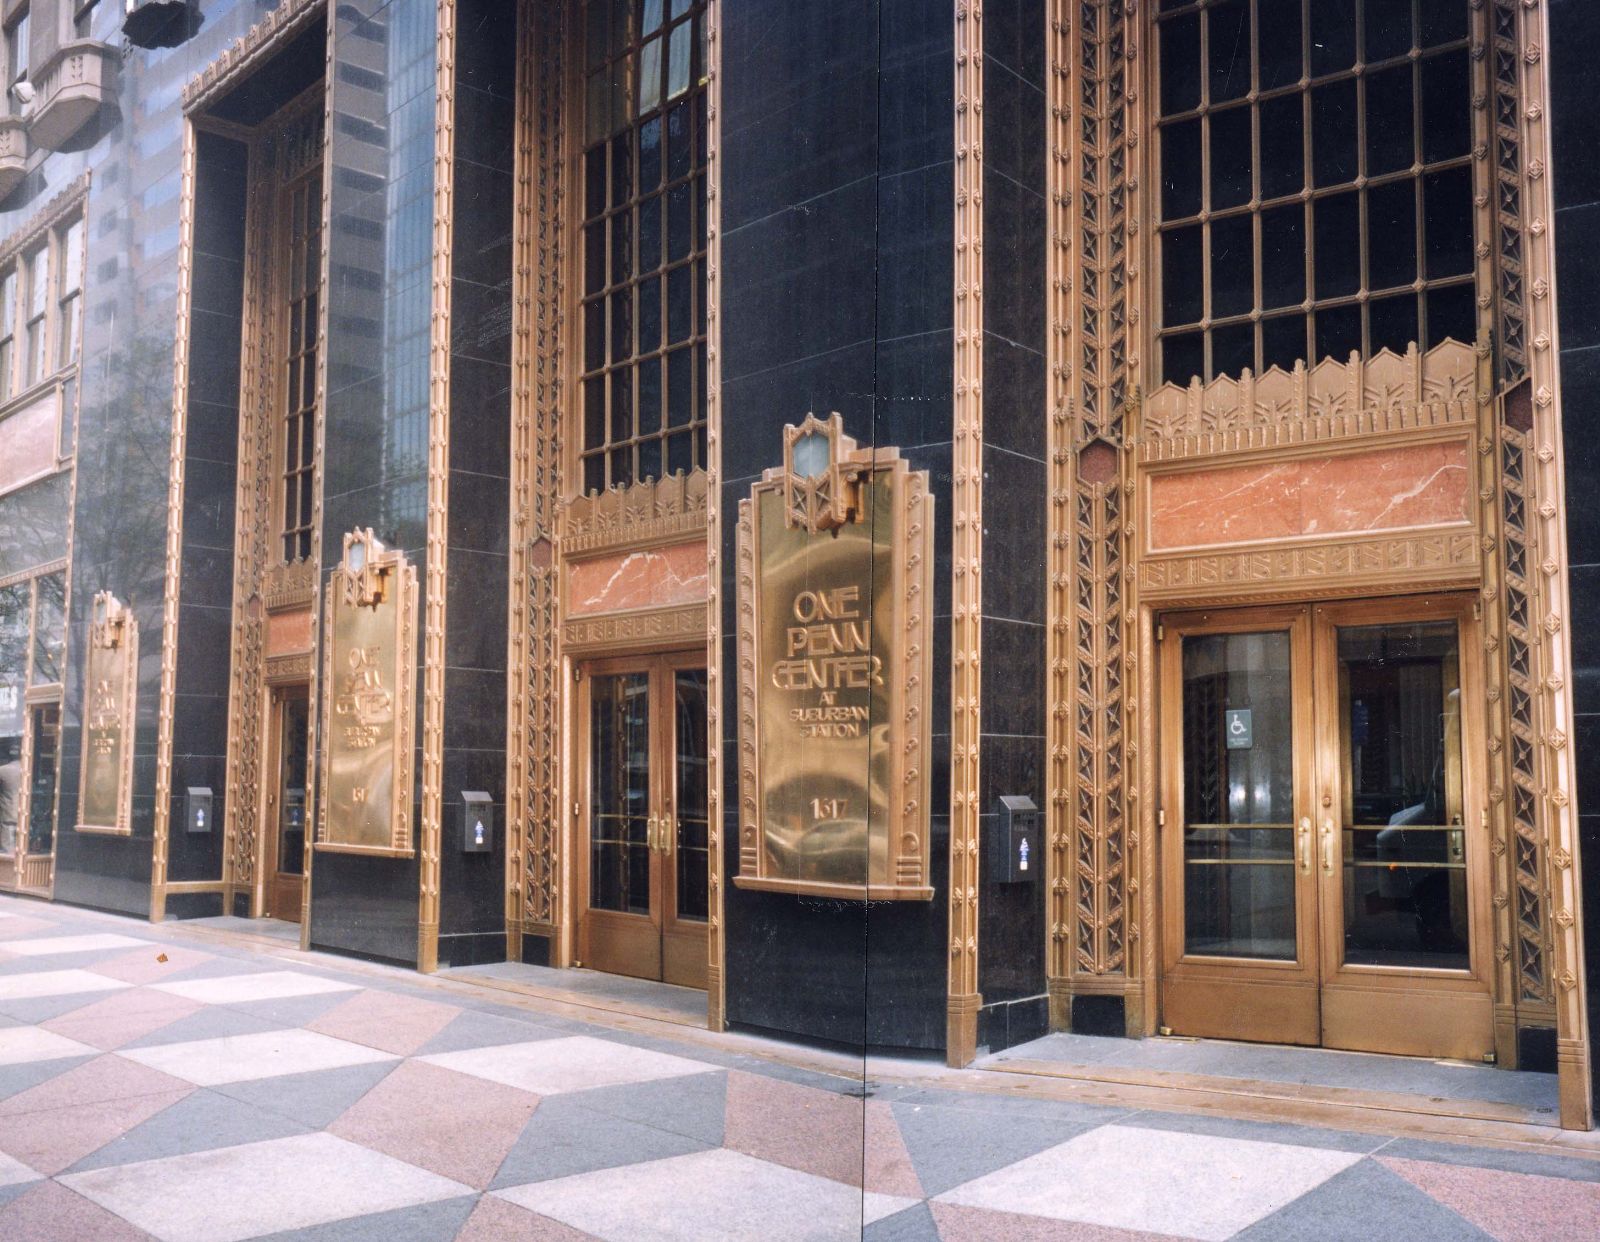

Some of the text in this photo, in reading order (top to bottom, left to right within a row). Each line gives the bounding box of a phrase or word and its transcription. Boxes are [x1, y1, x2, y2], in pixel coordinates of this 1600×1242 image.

[793, 585, 859, 623] ONE
[787, 620, 870, 657] PENN
[772, 655, 884, 689] CENTER
[820, 691, 837, 706] AT
[789, 706, 870, 721] SUBURBAN
[799, 722, 859, 738] STATION
[809, 798, 849, 820] 1617
